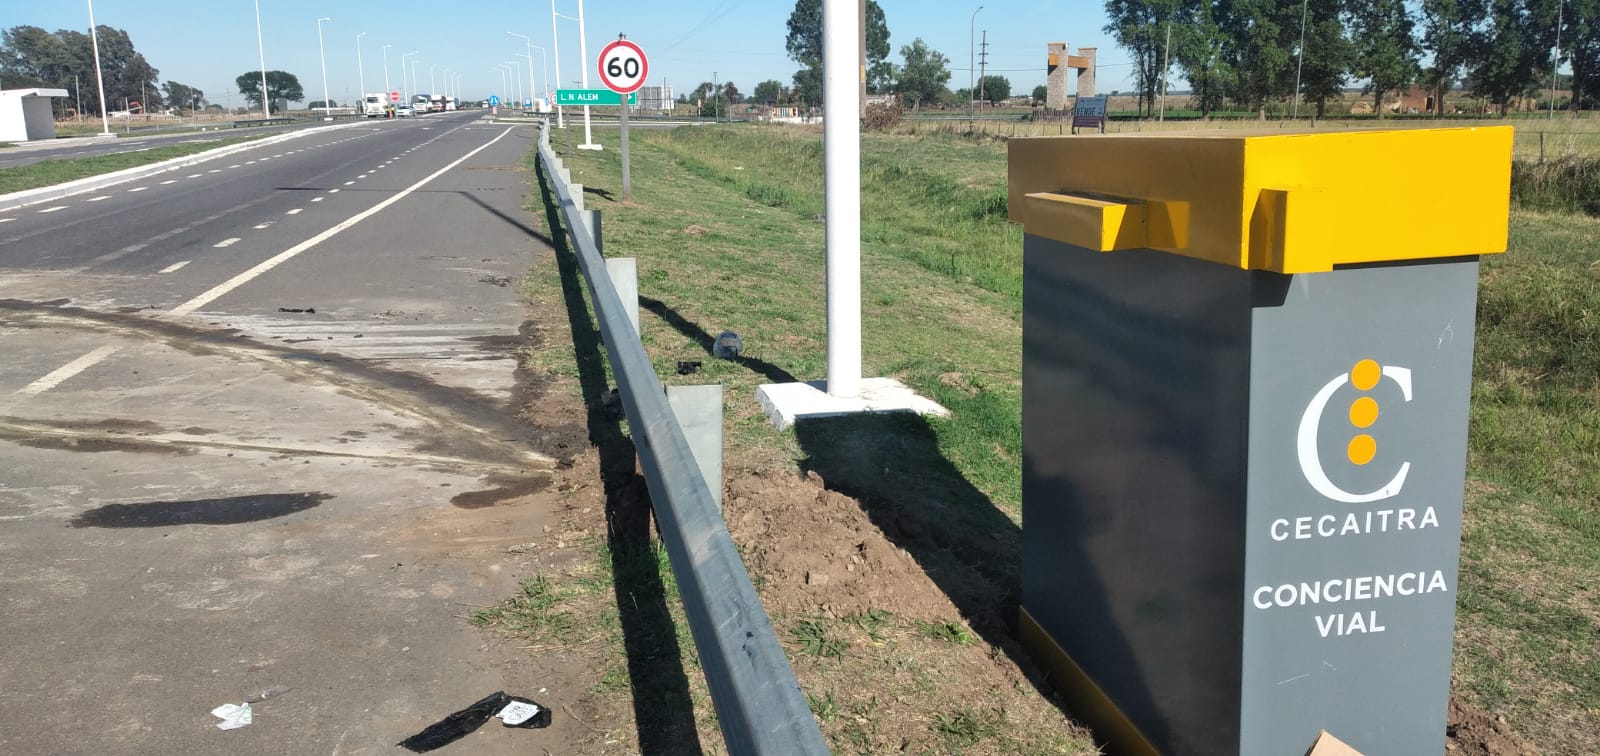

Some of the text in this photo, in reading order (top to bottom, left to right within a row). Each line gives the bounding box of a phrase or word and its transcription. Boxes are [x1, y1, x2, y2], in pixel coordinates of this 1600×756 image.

[607, 57, 639, 78] 60
[577, 93, 599, 101] ALEM
[1076, 106, 1096, 116] VENDE
[1270, 506, 1440, 541] CECAITRA
[1252, 569, 1448, 609] CONCIENCIA
[1315, 610, 1386, 638] VIAL
